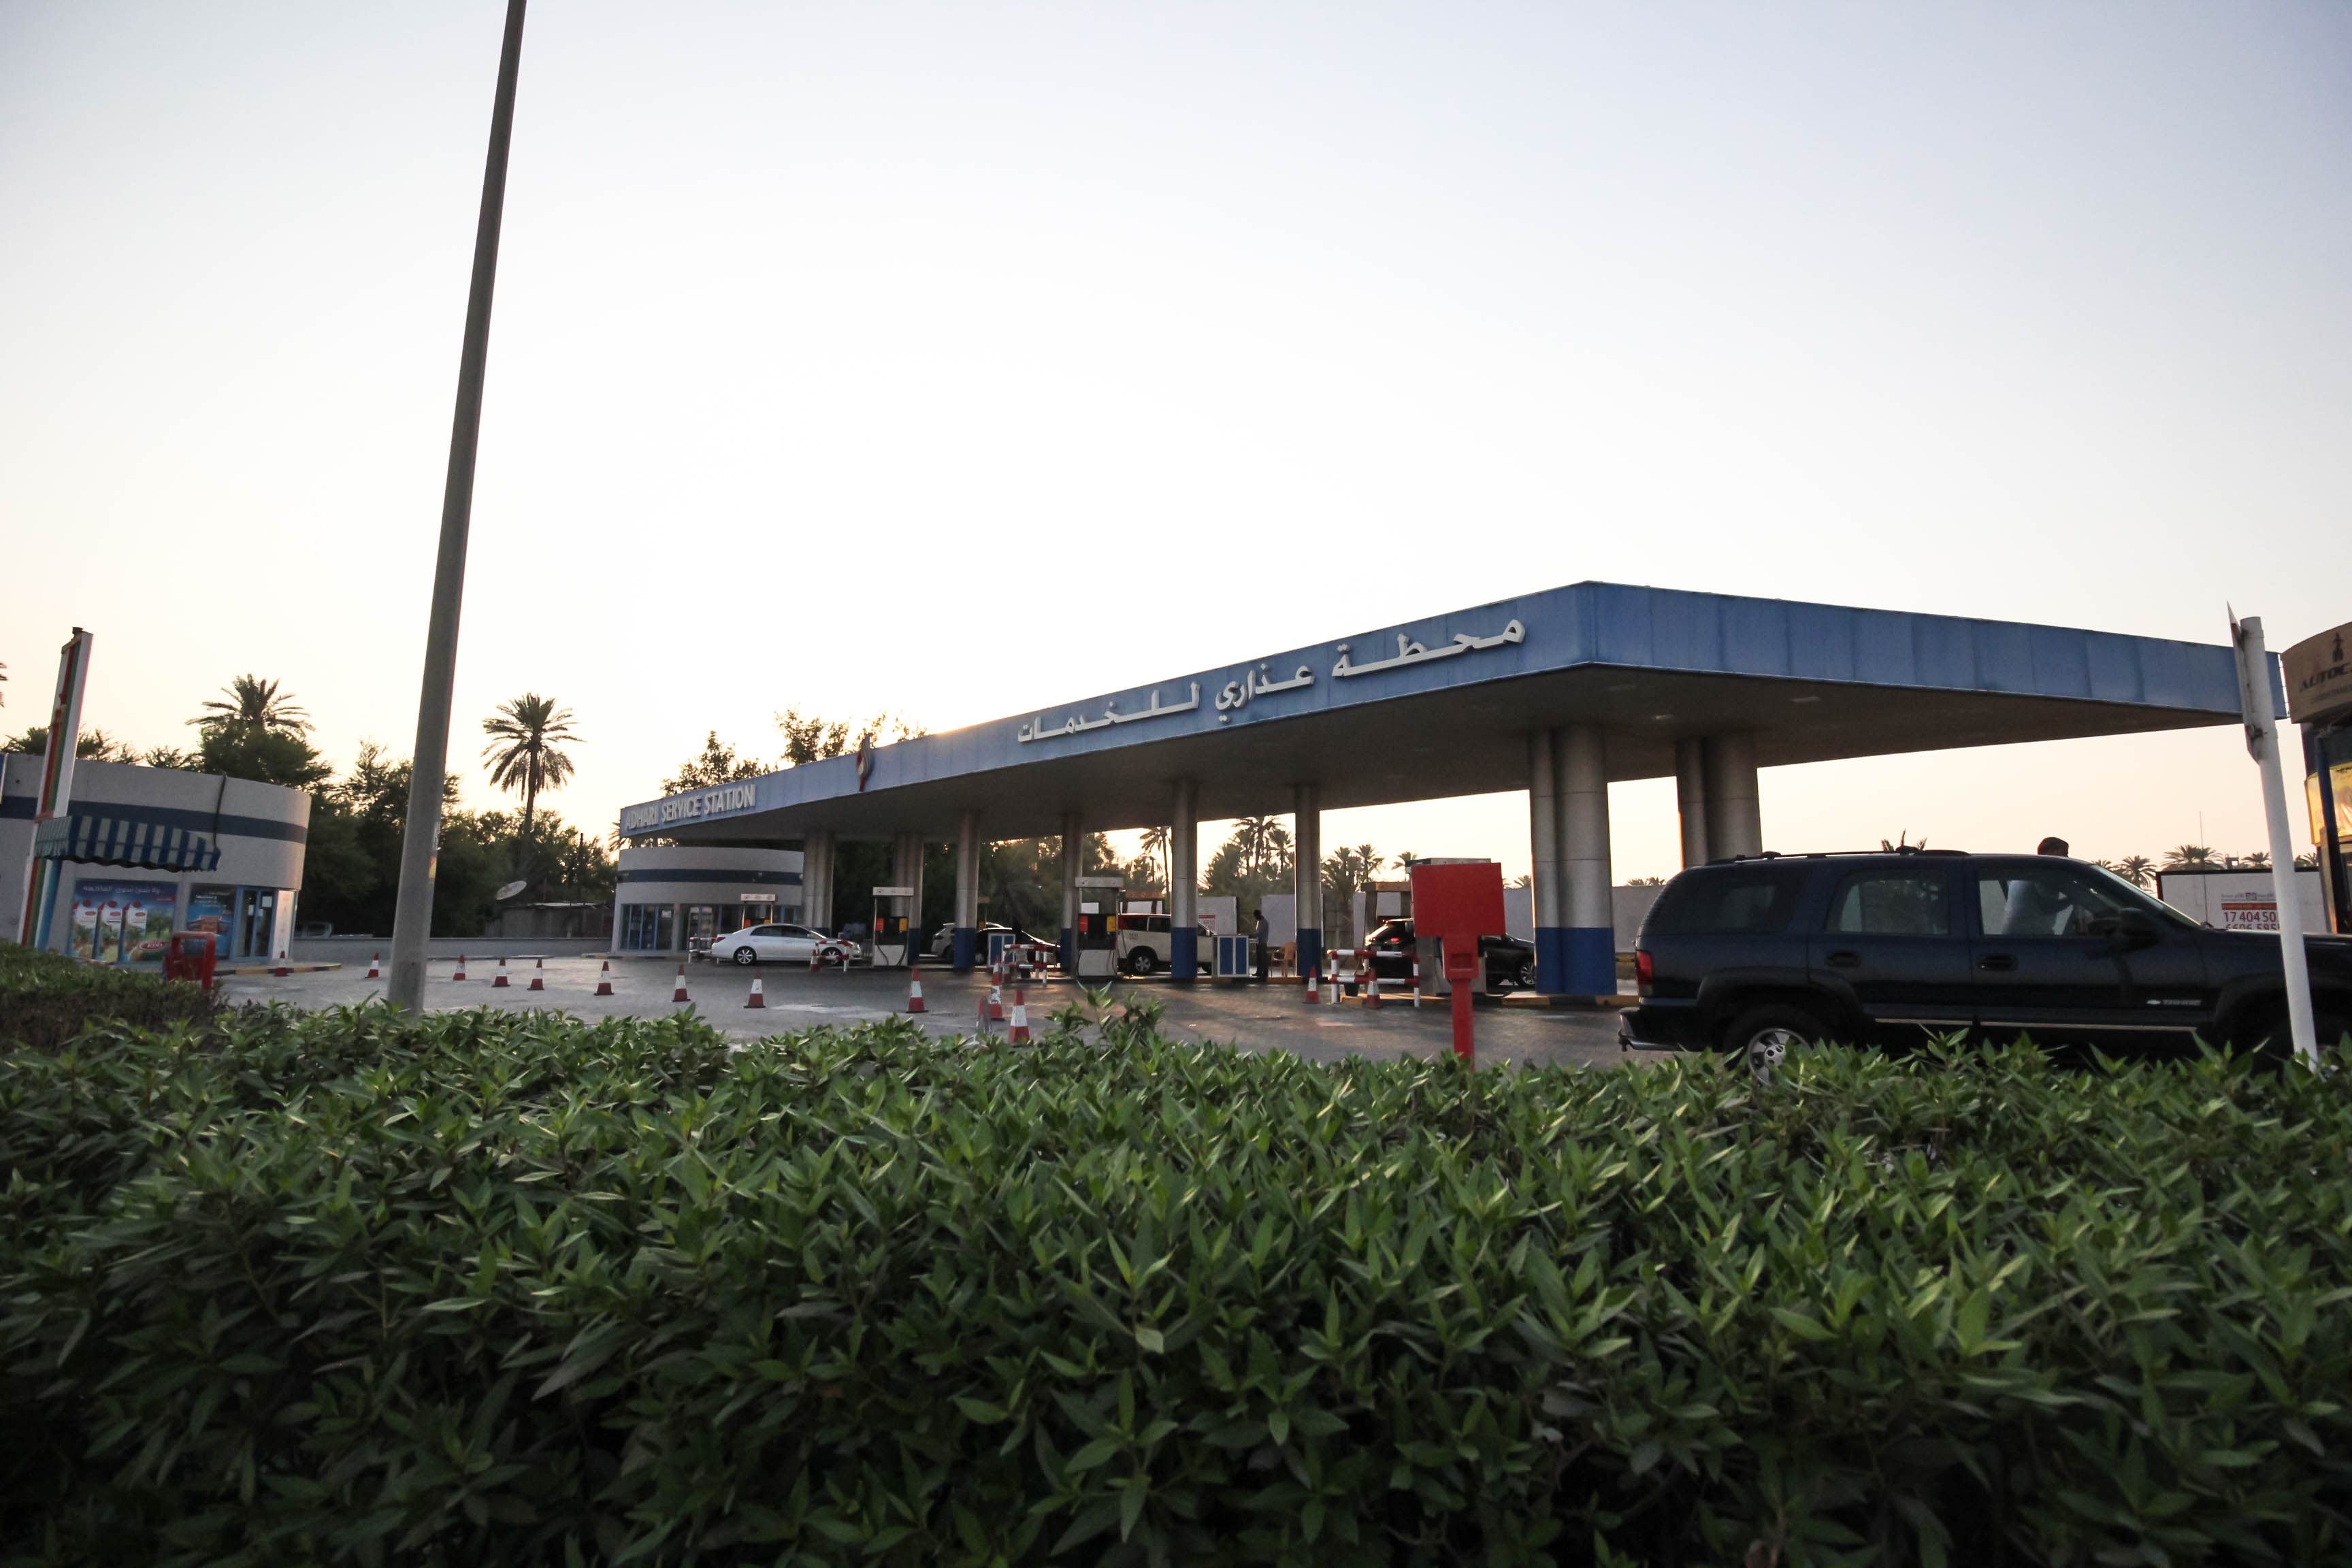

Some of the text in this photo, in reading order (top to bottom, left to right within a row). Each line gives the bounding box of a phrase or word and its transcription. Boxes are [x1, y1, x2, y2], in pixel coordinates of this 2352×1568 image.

[1018, 619, 1526, 742] محطة عذاري للخدمات
[2300, 662, 2352, 691] AUTOC
[625, 784, 756, 830] ADHARI SERVICE STATION
[2263, 911, 2278, 923] 50
